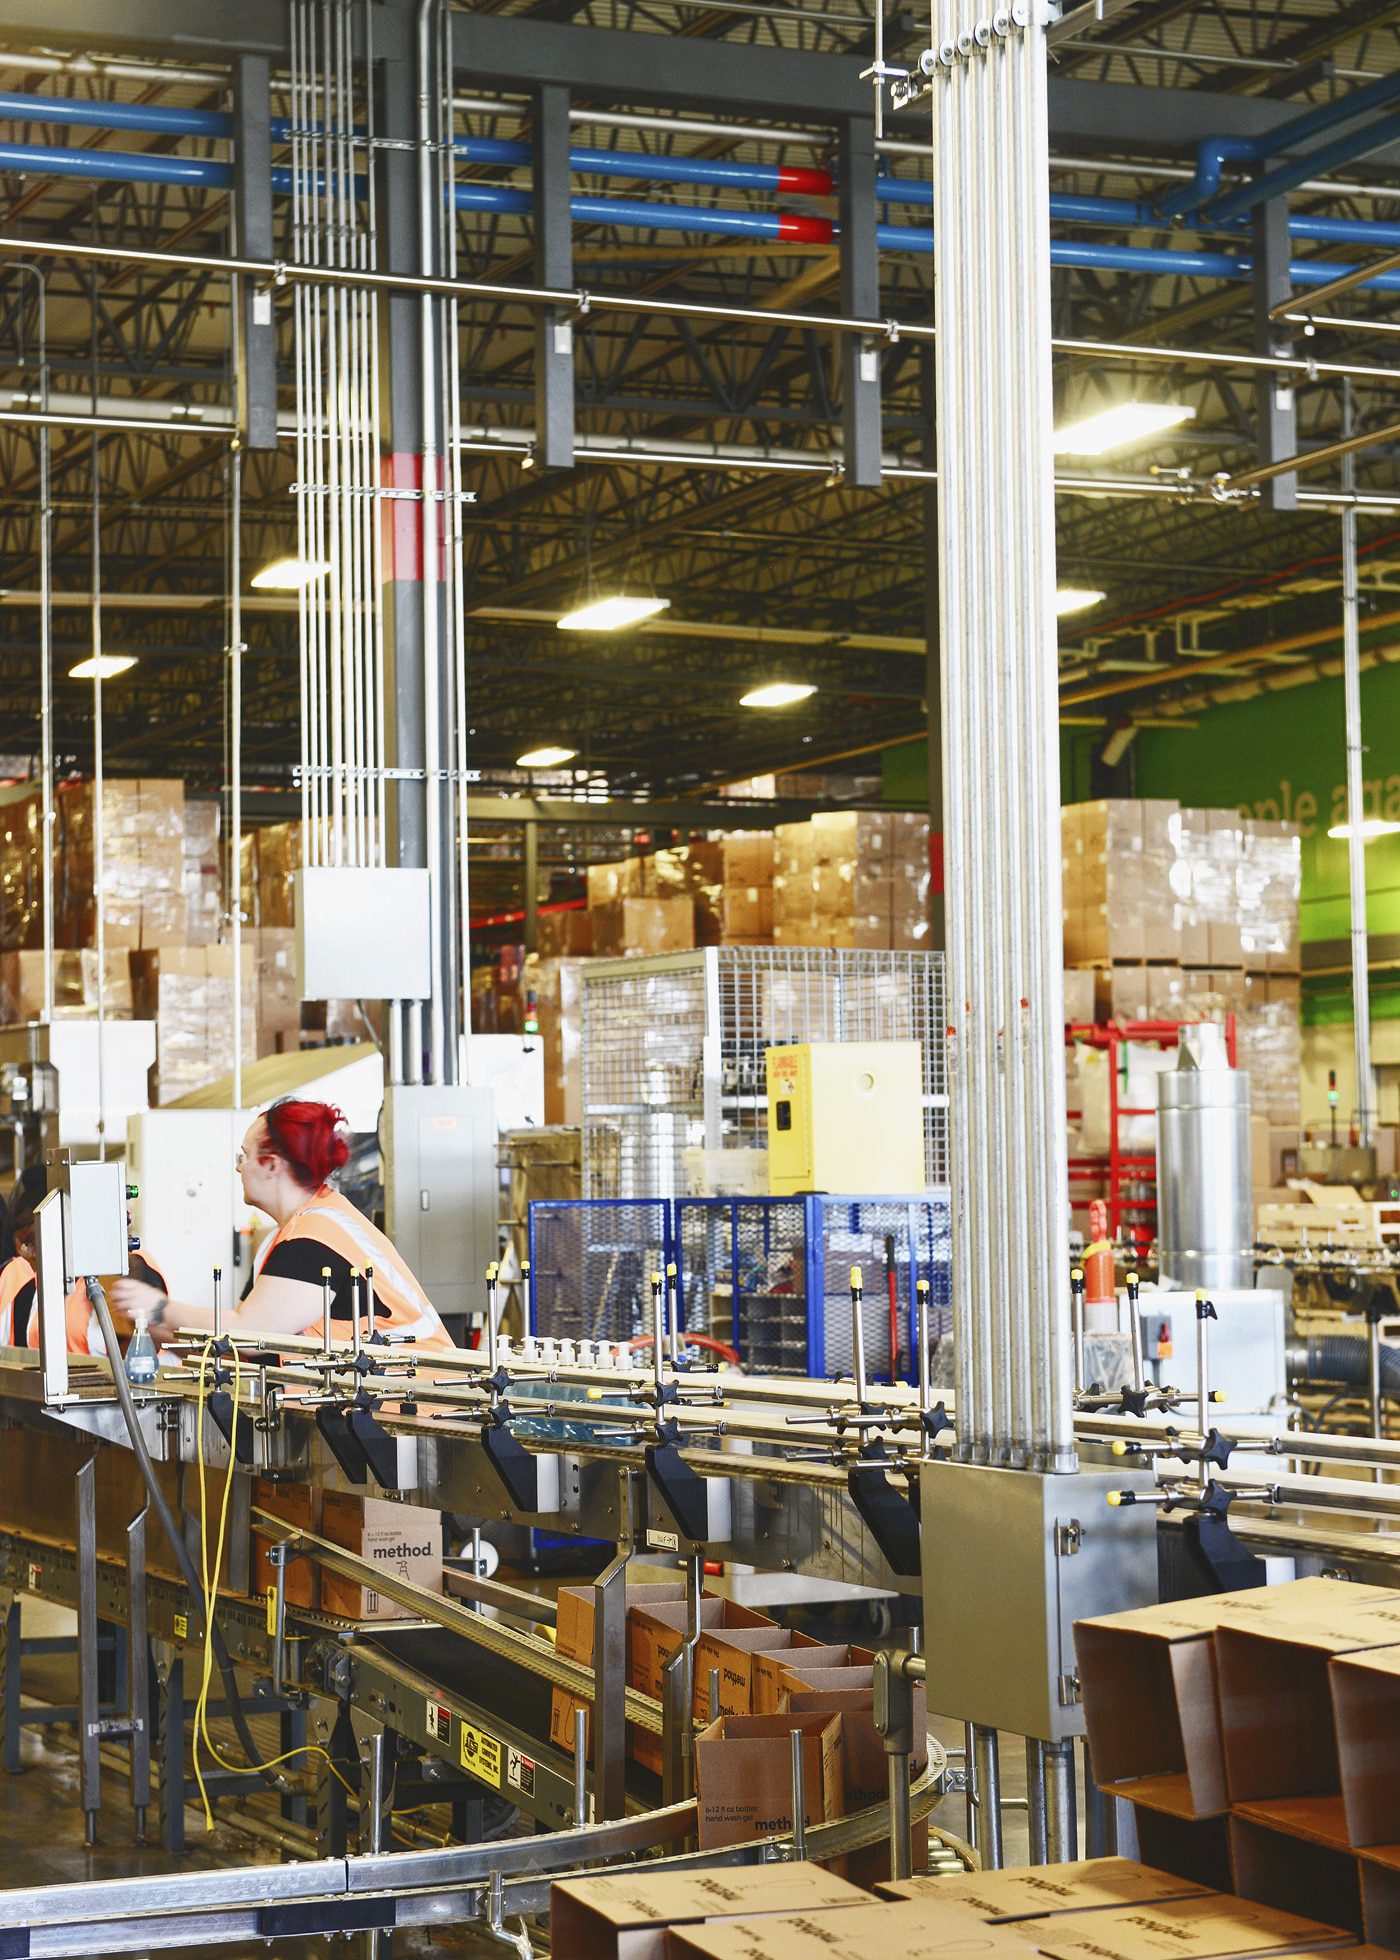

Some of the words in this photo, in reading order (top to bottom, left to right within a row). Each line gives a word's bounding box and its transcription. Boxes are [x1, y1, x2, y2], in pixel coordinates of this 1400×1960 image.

[373, 1541, 431, 1559] method
[723, 1668, 746, 1688] method
[755, 1815, 811, 1831] methd
